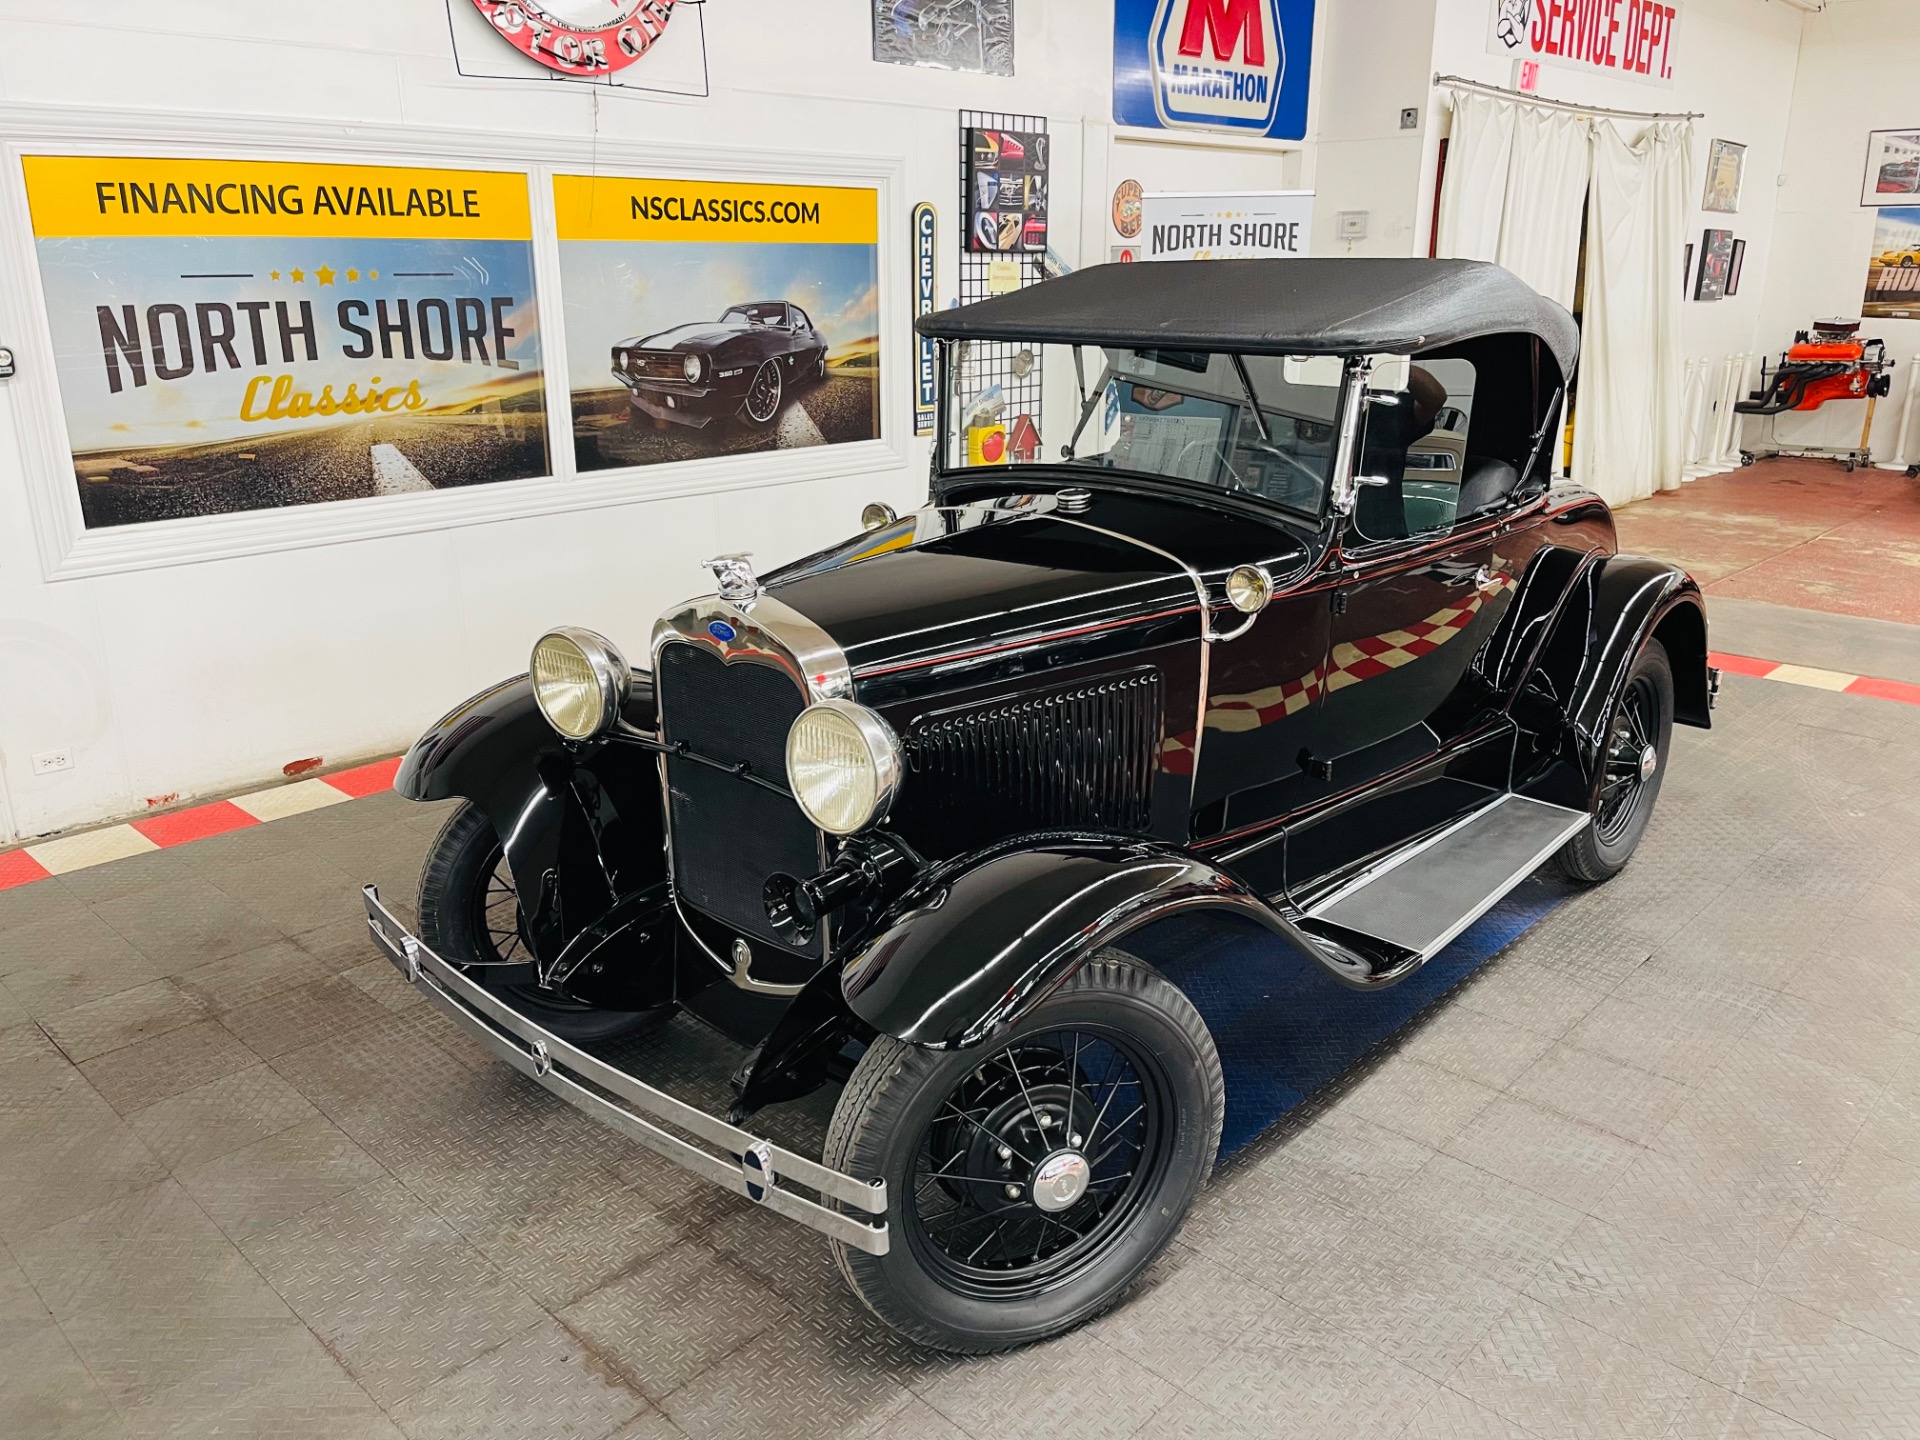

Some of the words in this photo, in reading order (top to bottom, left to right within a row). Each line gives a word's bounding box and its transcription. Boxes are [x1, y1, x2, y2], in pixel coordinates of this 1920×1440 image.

[480, 0, 610, 71] OTOR
[1530, 0, 1622, 68] SERVICE
[1622, 0, 1676, 80] DEPT.
[1171, 63, 1269, 104] MARATHON
[1520, 61, 1539, 92] EXIT
[95, 182, 303, 216] FINANCING
[312, 185, 481, 219] AVAILABLE
[630, 195, 820, 225] NSCLASSICS.COM
[1152, 224, 1222, 255] NORTH
[1229, 222, 1300, 252] SHORE
[1876, 267, 1920, 291] RID
[920, 214, 933, 402] CHEVRLET
[96, 299, 319, 395] NORTH
[337, 296, 521, 371] SHORE
[239, 374, 428, 423] Classics
[917, 421, 933, 429] SERVI
